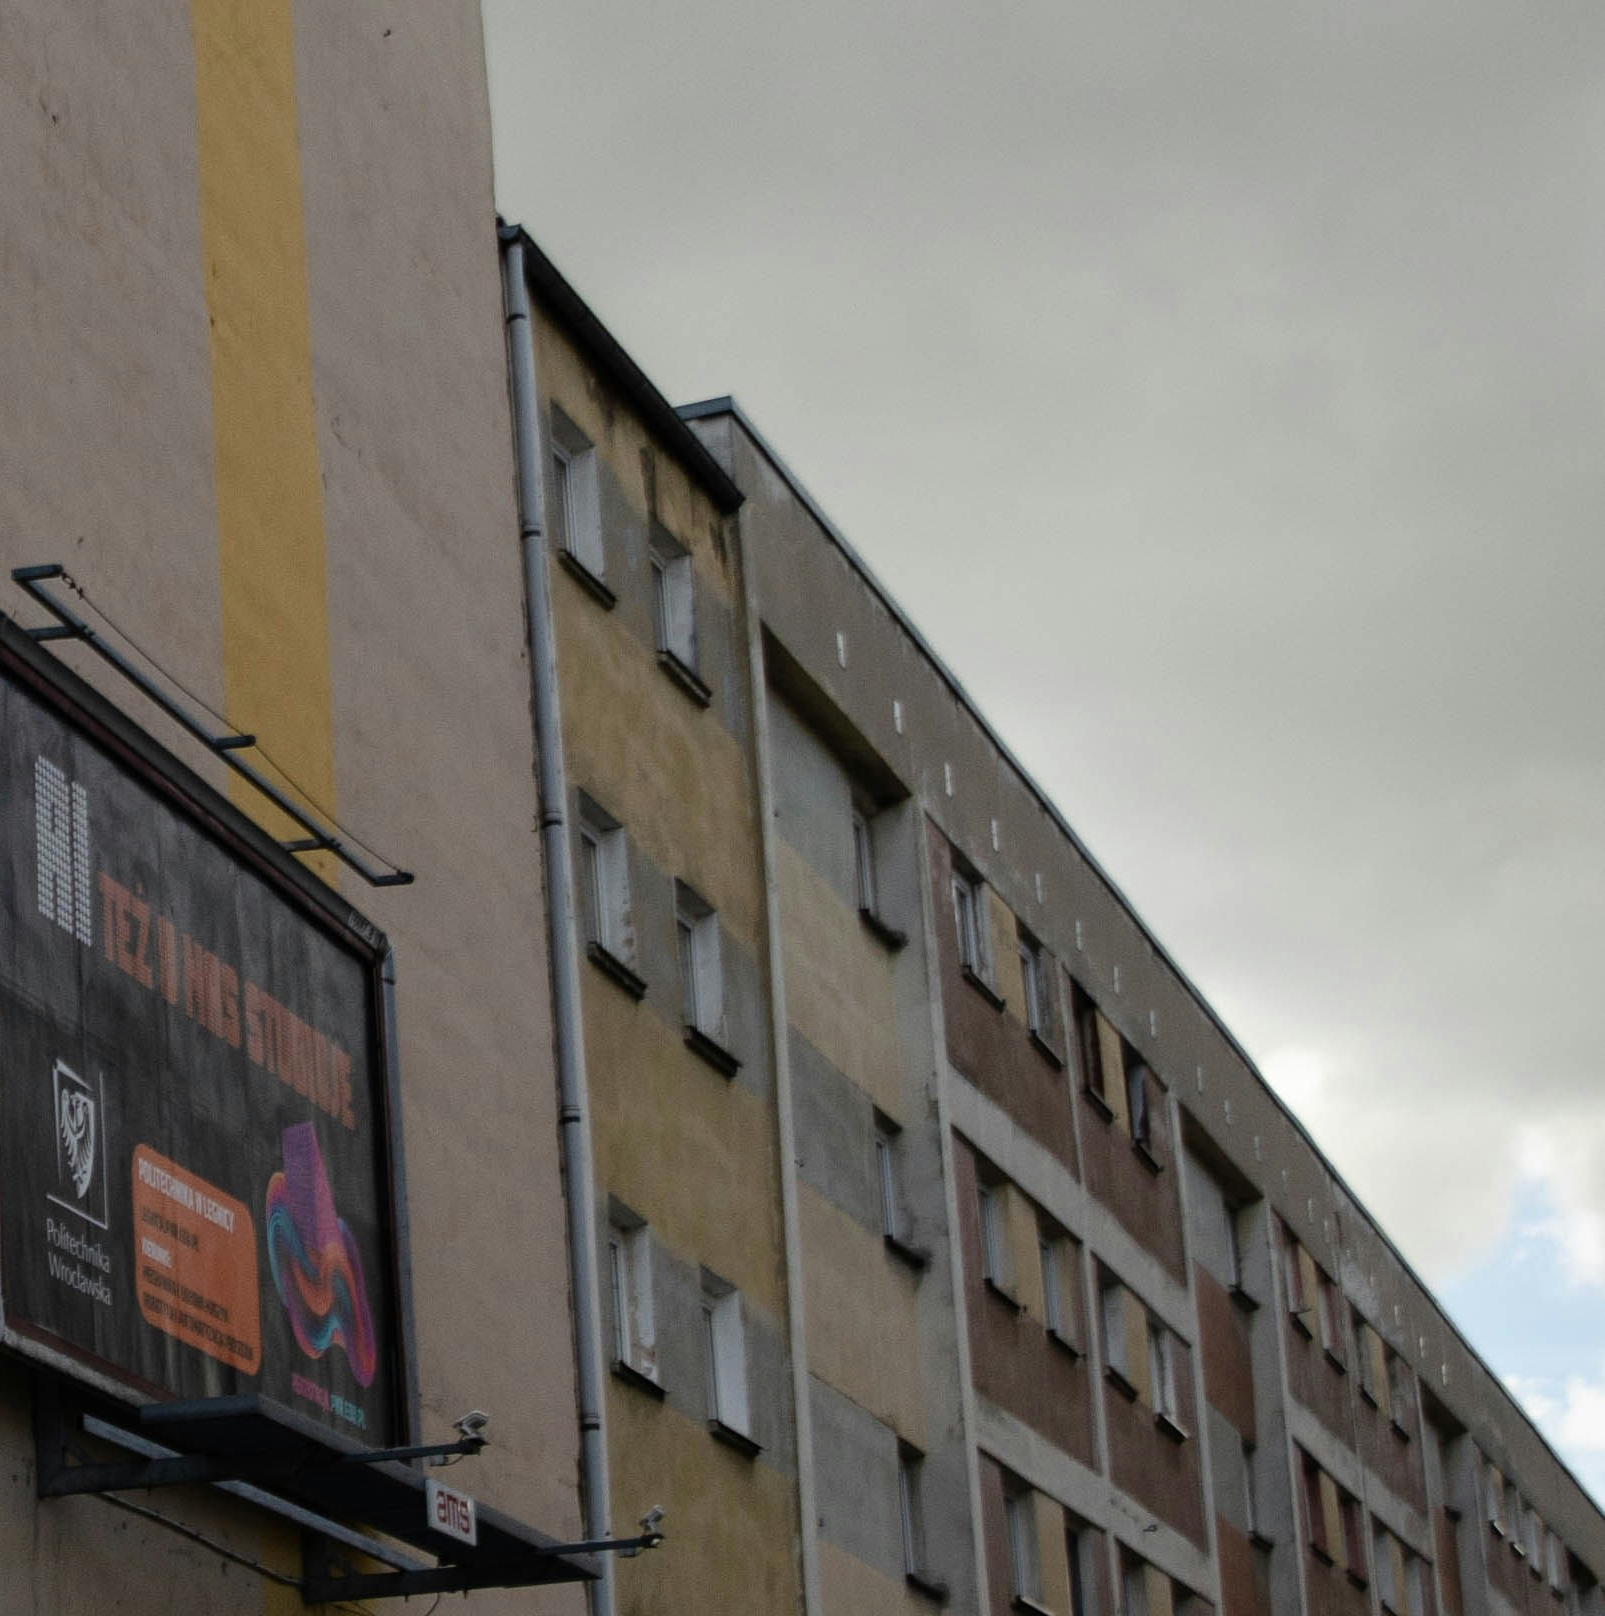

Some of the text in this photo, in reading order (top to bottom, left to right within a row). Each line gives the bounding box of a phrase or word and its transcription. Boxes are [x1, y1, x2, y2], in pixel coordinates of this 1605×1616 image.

[35, 755, 92, 947] AI
[46, 1218, 111, 1274] Politechnika
[48, 1252, 112, 1306] Wrocławska
[436, 1490, 470, 1534] ams
